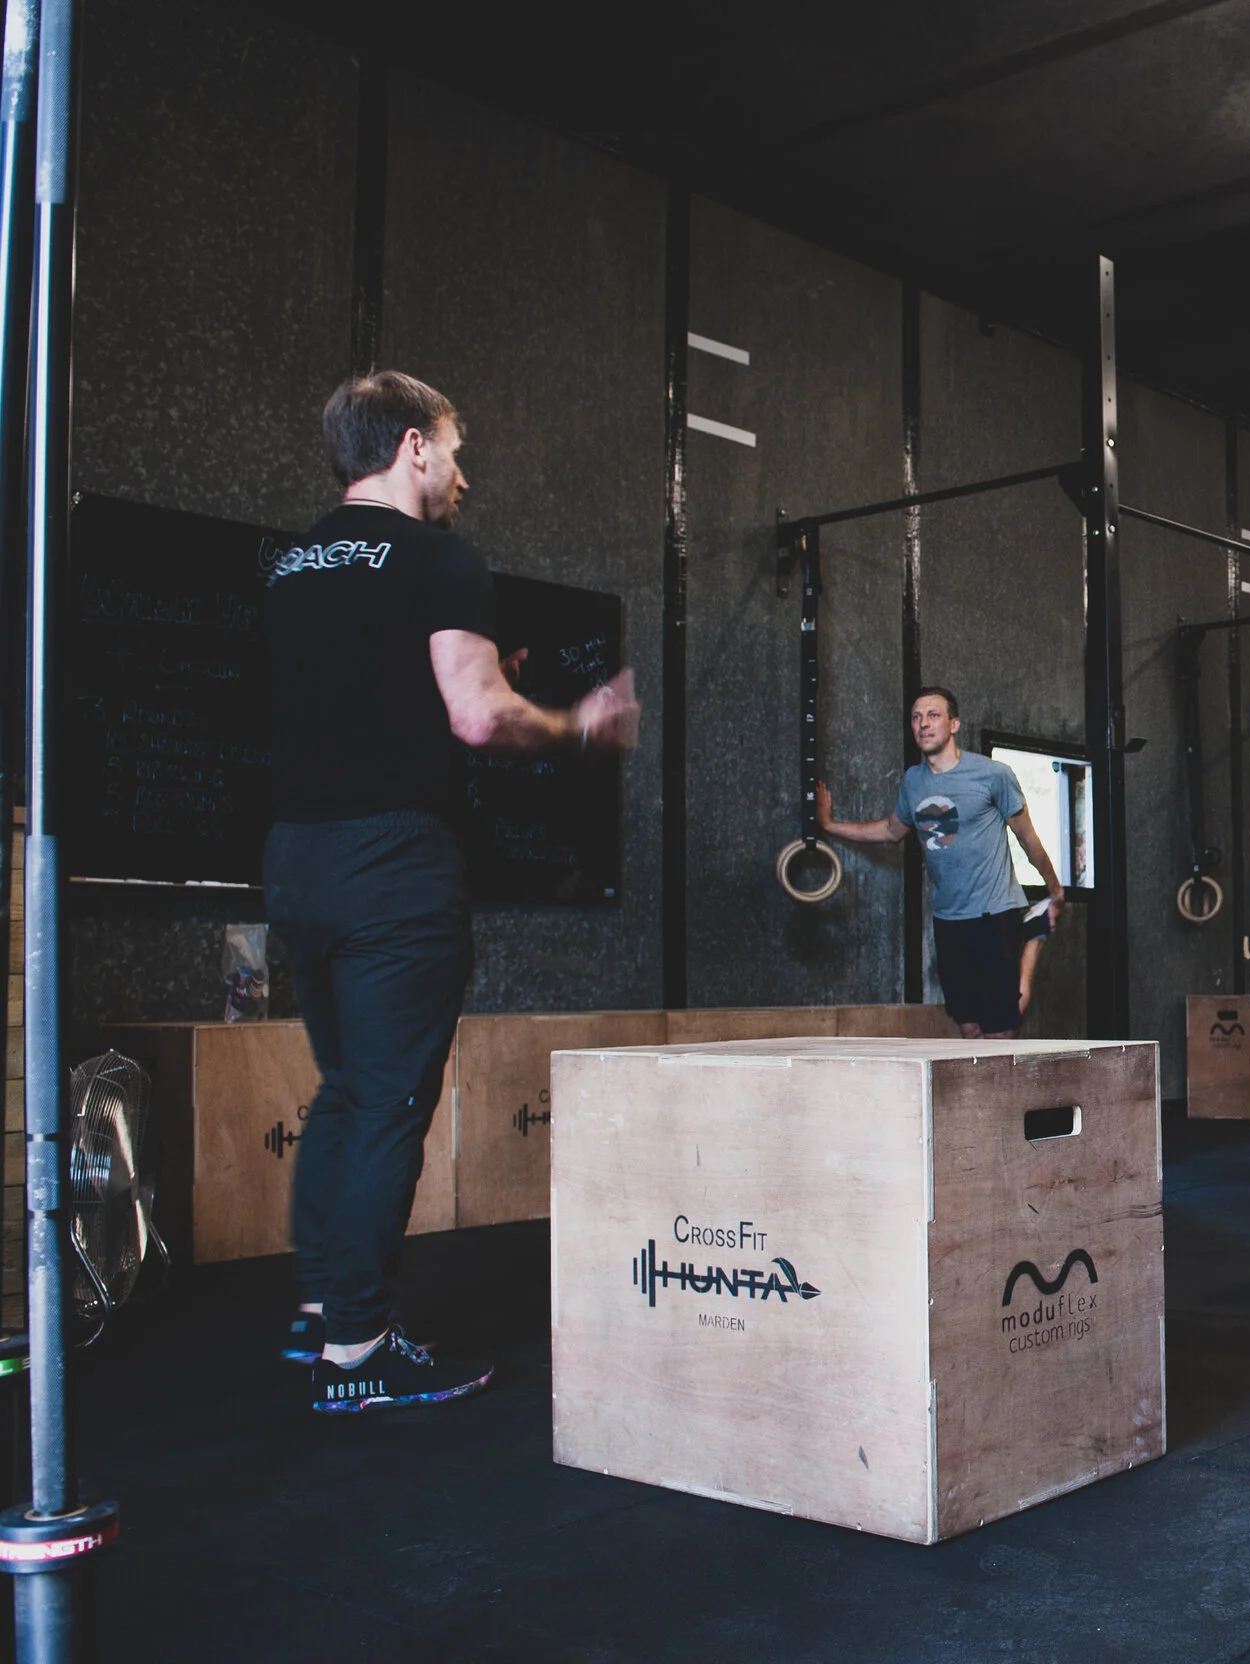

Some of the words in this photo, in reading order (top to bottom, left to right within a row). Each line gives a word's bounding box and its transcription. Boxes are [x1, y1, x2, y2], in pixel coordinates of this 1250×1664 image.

[559, 647, 580, 667] 30
[661, 1260, 788, 1303] HUNTA
[698, 1313, 745, 1331] MARDEN
[1002, 1293, 1097, 1334] moduflex
[1009, 1324, 1064, 1354] custom
[1068, 1317, 1091, 1341] rigs
[327, 1379, 386, 1400] NOBULL
